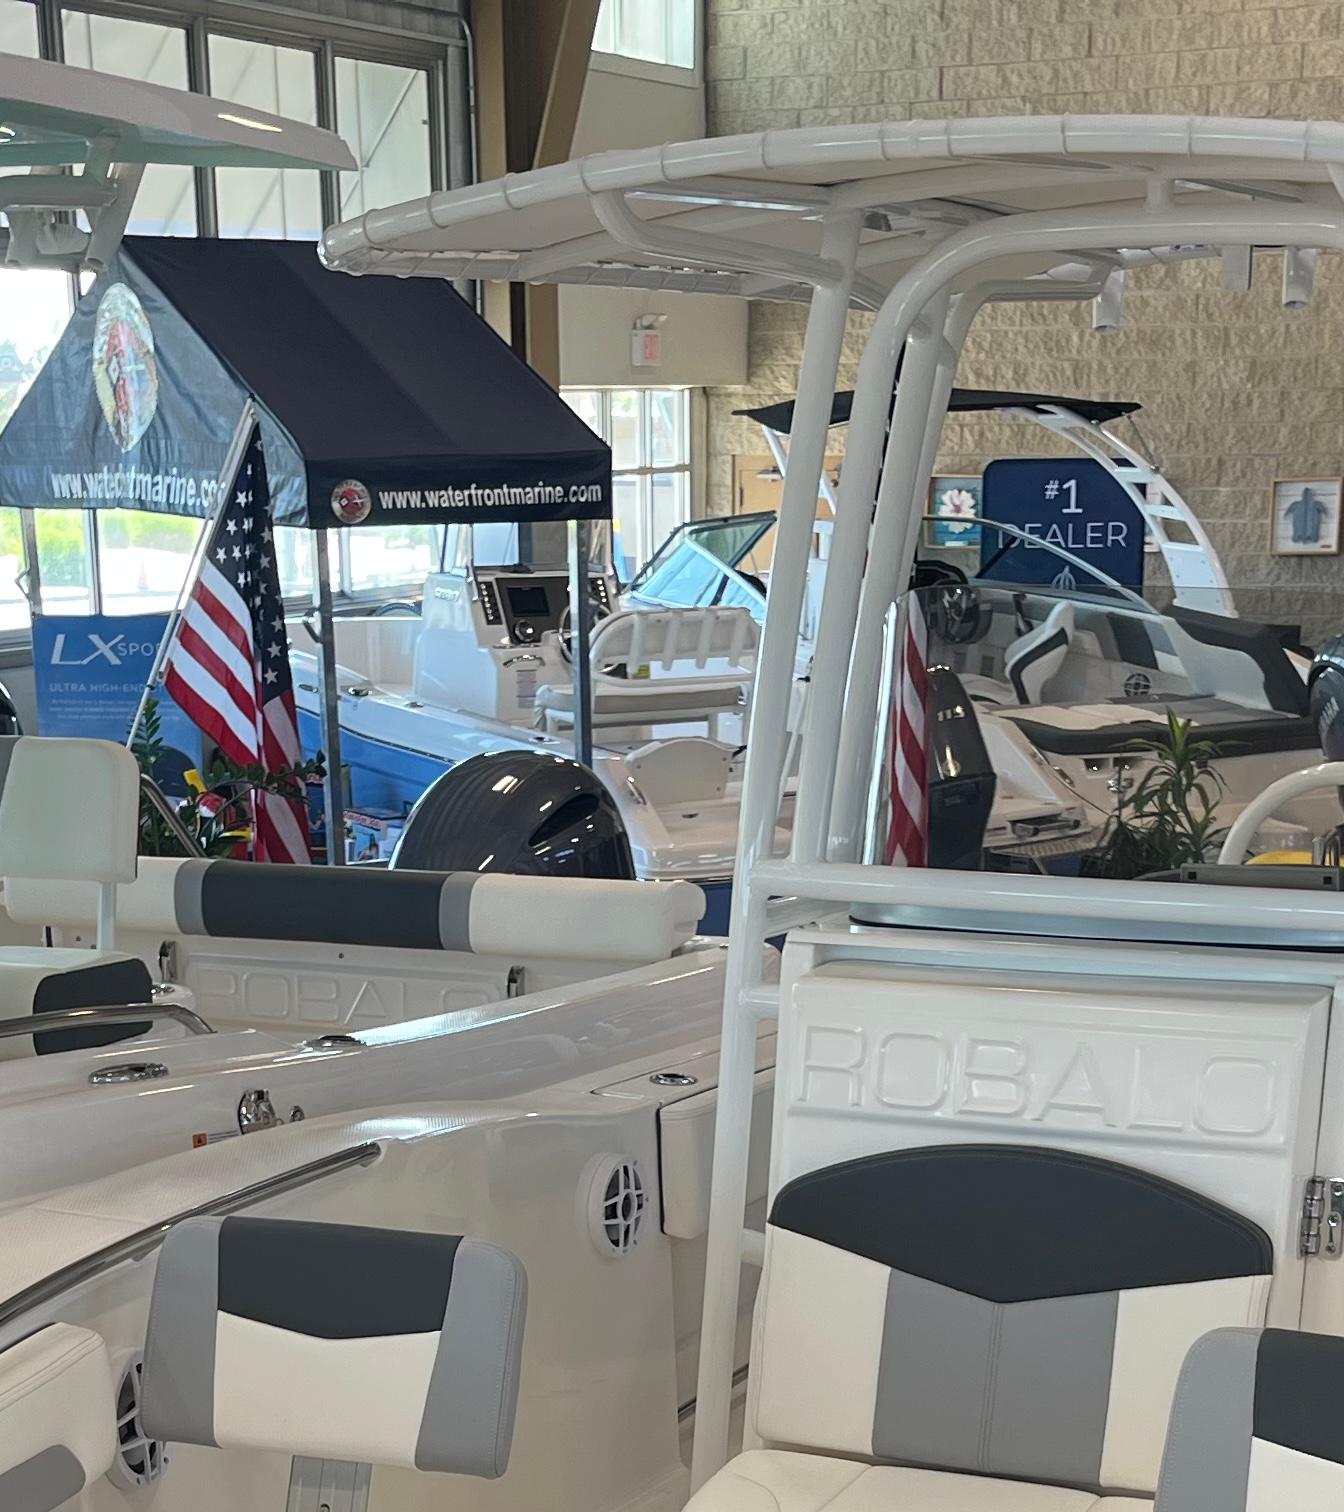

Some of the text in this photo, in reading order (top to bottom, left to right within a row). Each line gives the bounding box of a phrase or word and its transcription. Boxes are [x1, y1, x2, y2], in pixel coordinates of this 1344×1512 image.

[379, 482, 602, 510] www.waterfrontmarine.com
[1044, 479, 1084, 514] #1
[998, 521, 1128, 549] DEALER
[51, 634, 161, 666] LX SPO
[50, 683, 87, 693] ULTRA
[797, 1025, 1277, 1137] ROBALO
